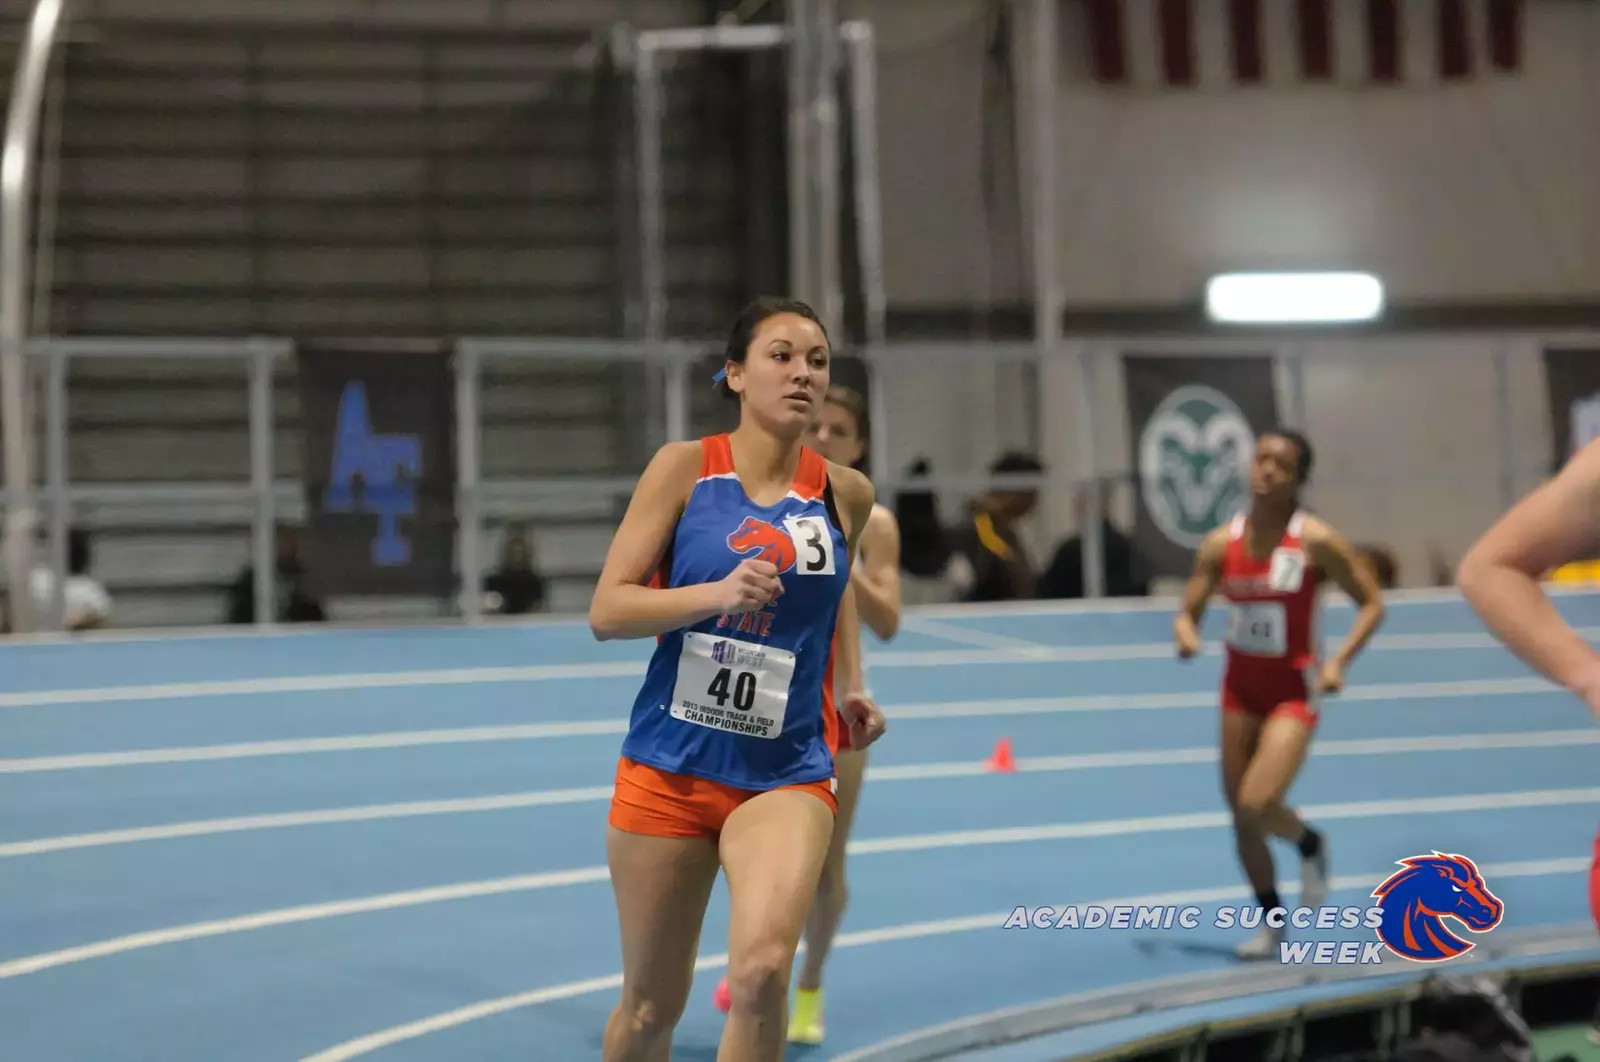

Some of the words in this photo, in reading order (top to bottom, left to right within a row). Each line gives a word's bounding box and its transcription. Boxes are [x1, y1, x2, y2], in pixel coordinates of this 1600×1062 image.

[797, 519, 826, 572] 3
[737, 656, 764, 667] WEST
[707, 667, 757, 711] 40
[682, 700, 698, 710] 2013
[699, 705, 725, 717] INDOOR
[726, 710, 748, 721] TRACK
[756, 717, 775, 727] FIELD
[684, 709, 768, 736] CHAMPIONSHIPS
